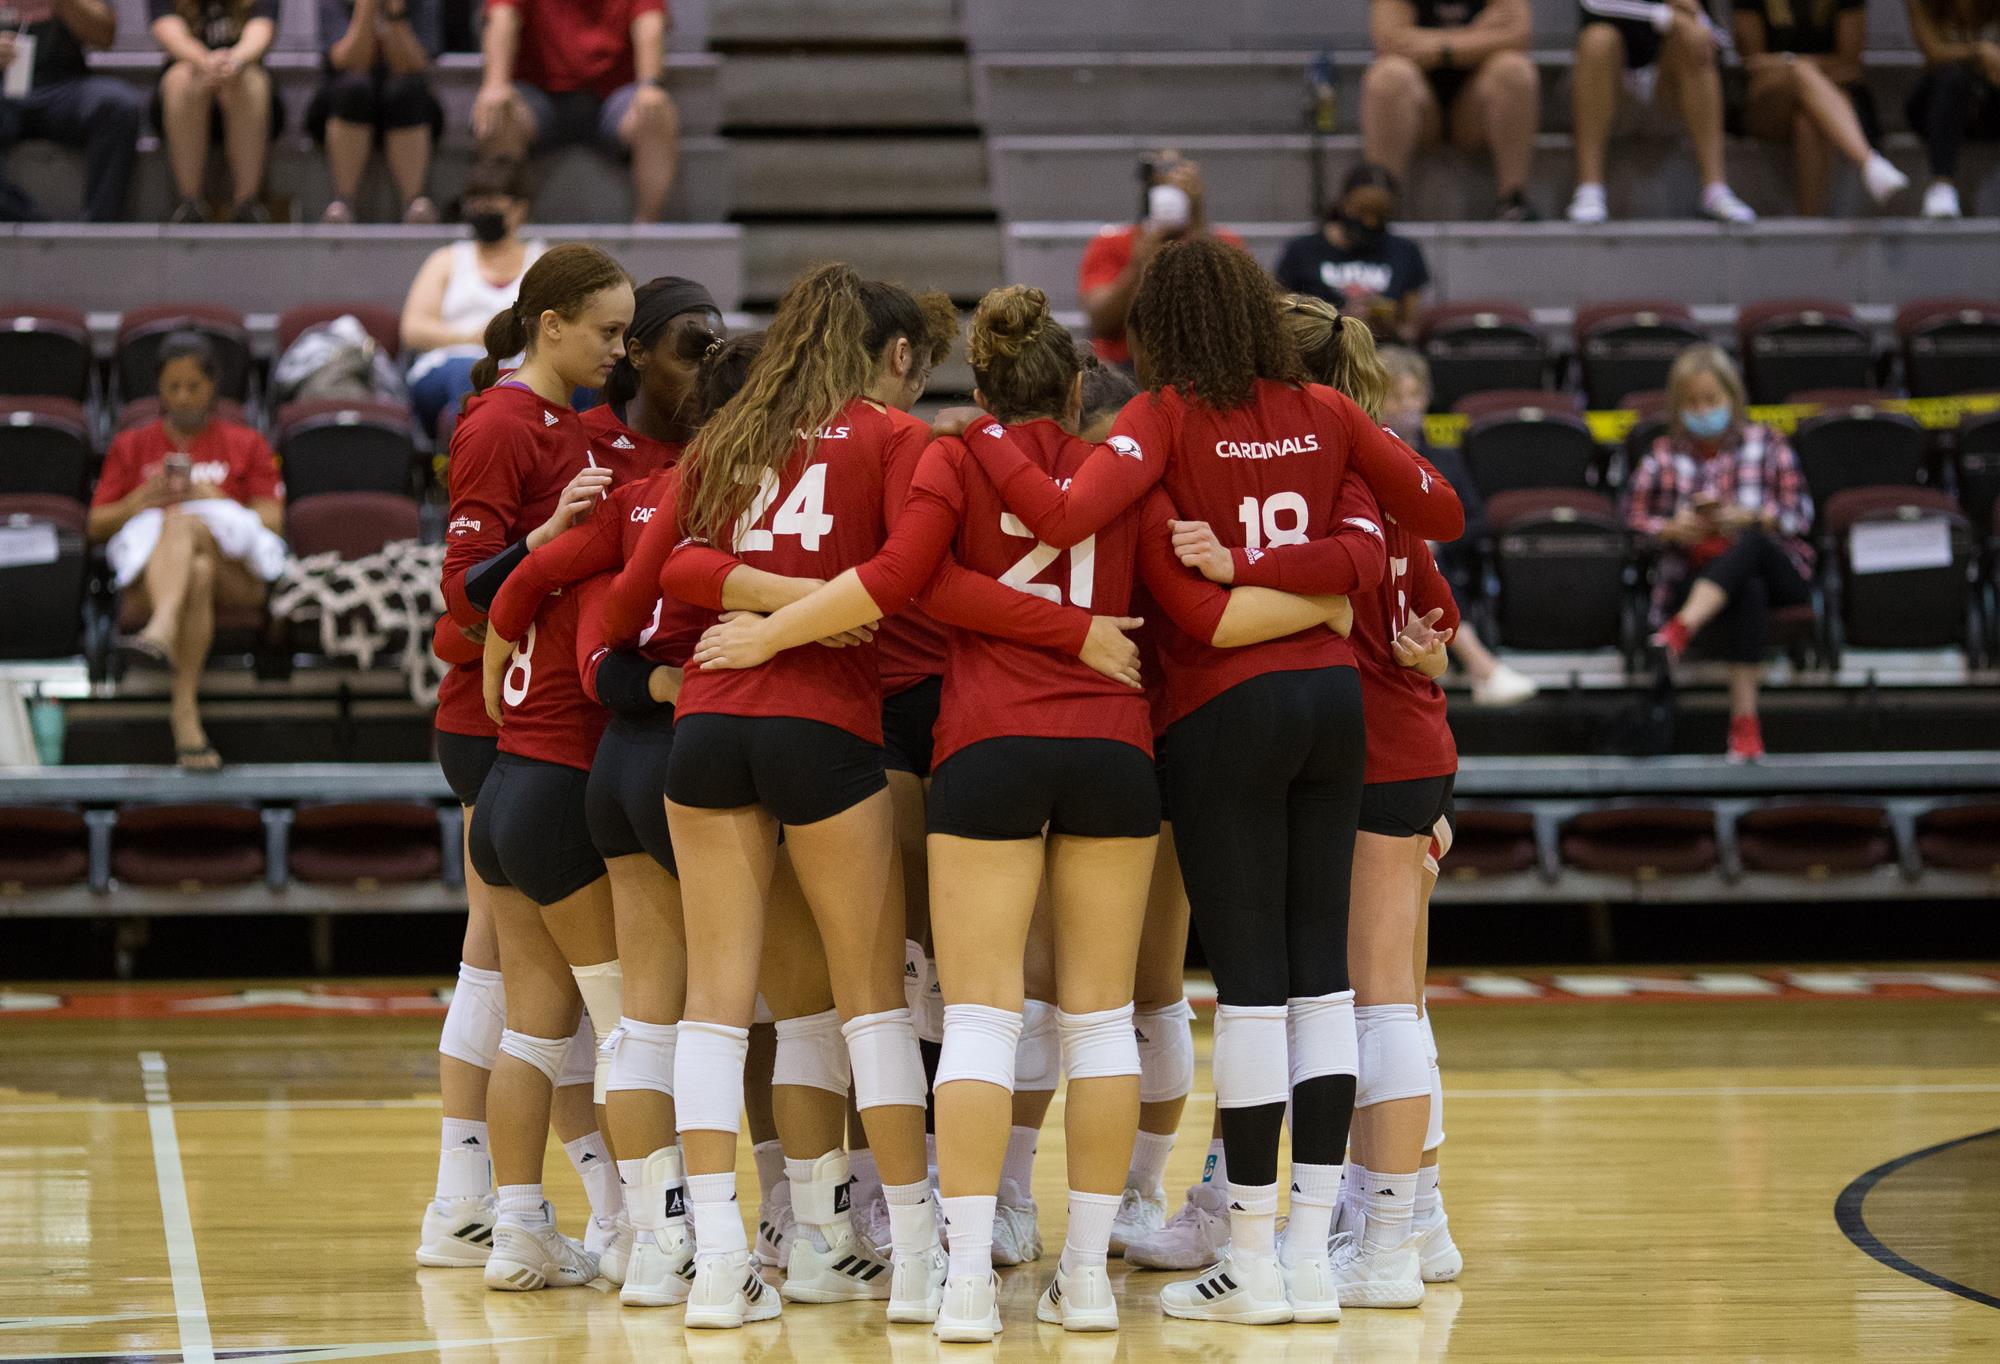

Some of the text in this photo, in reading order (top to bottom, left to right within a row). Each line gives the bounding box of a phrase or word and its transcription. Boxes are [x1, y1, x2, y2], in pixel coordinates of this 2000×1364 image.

[1215, 434, 1318, 459] CARDINALS
[732, 463, 834, 554] 24
[1239, 491, 1310, 549] 18
[997, 512, 1096, 609] 21
[503, 621, 537, 707] 8
